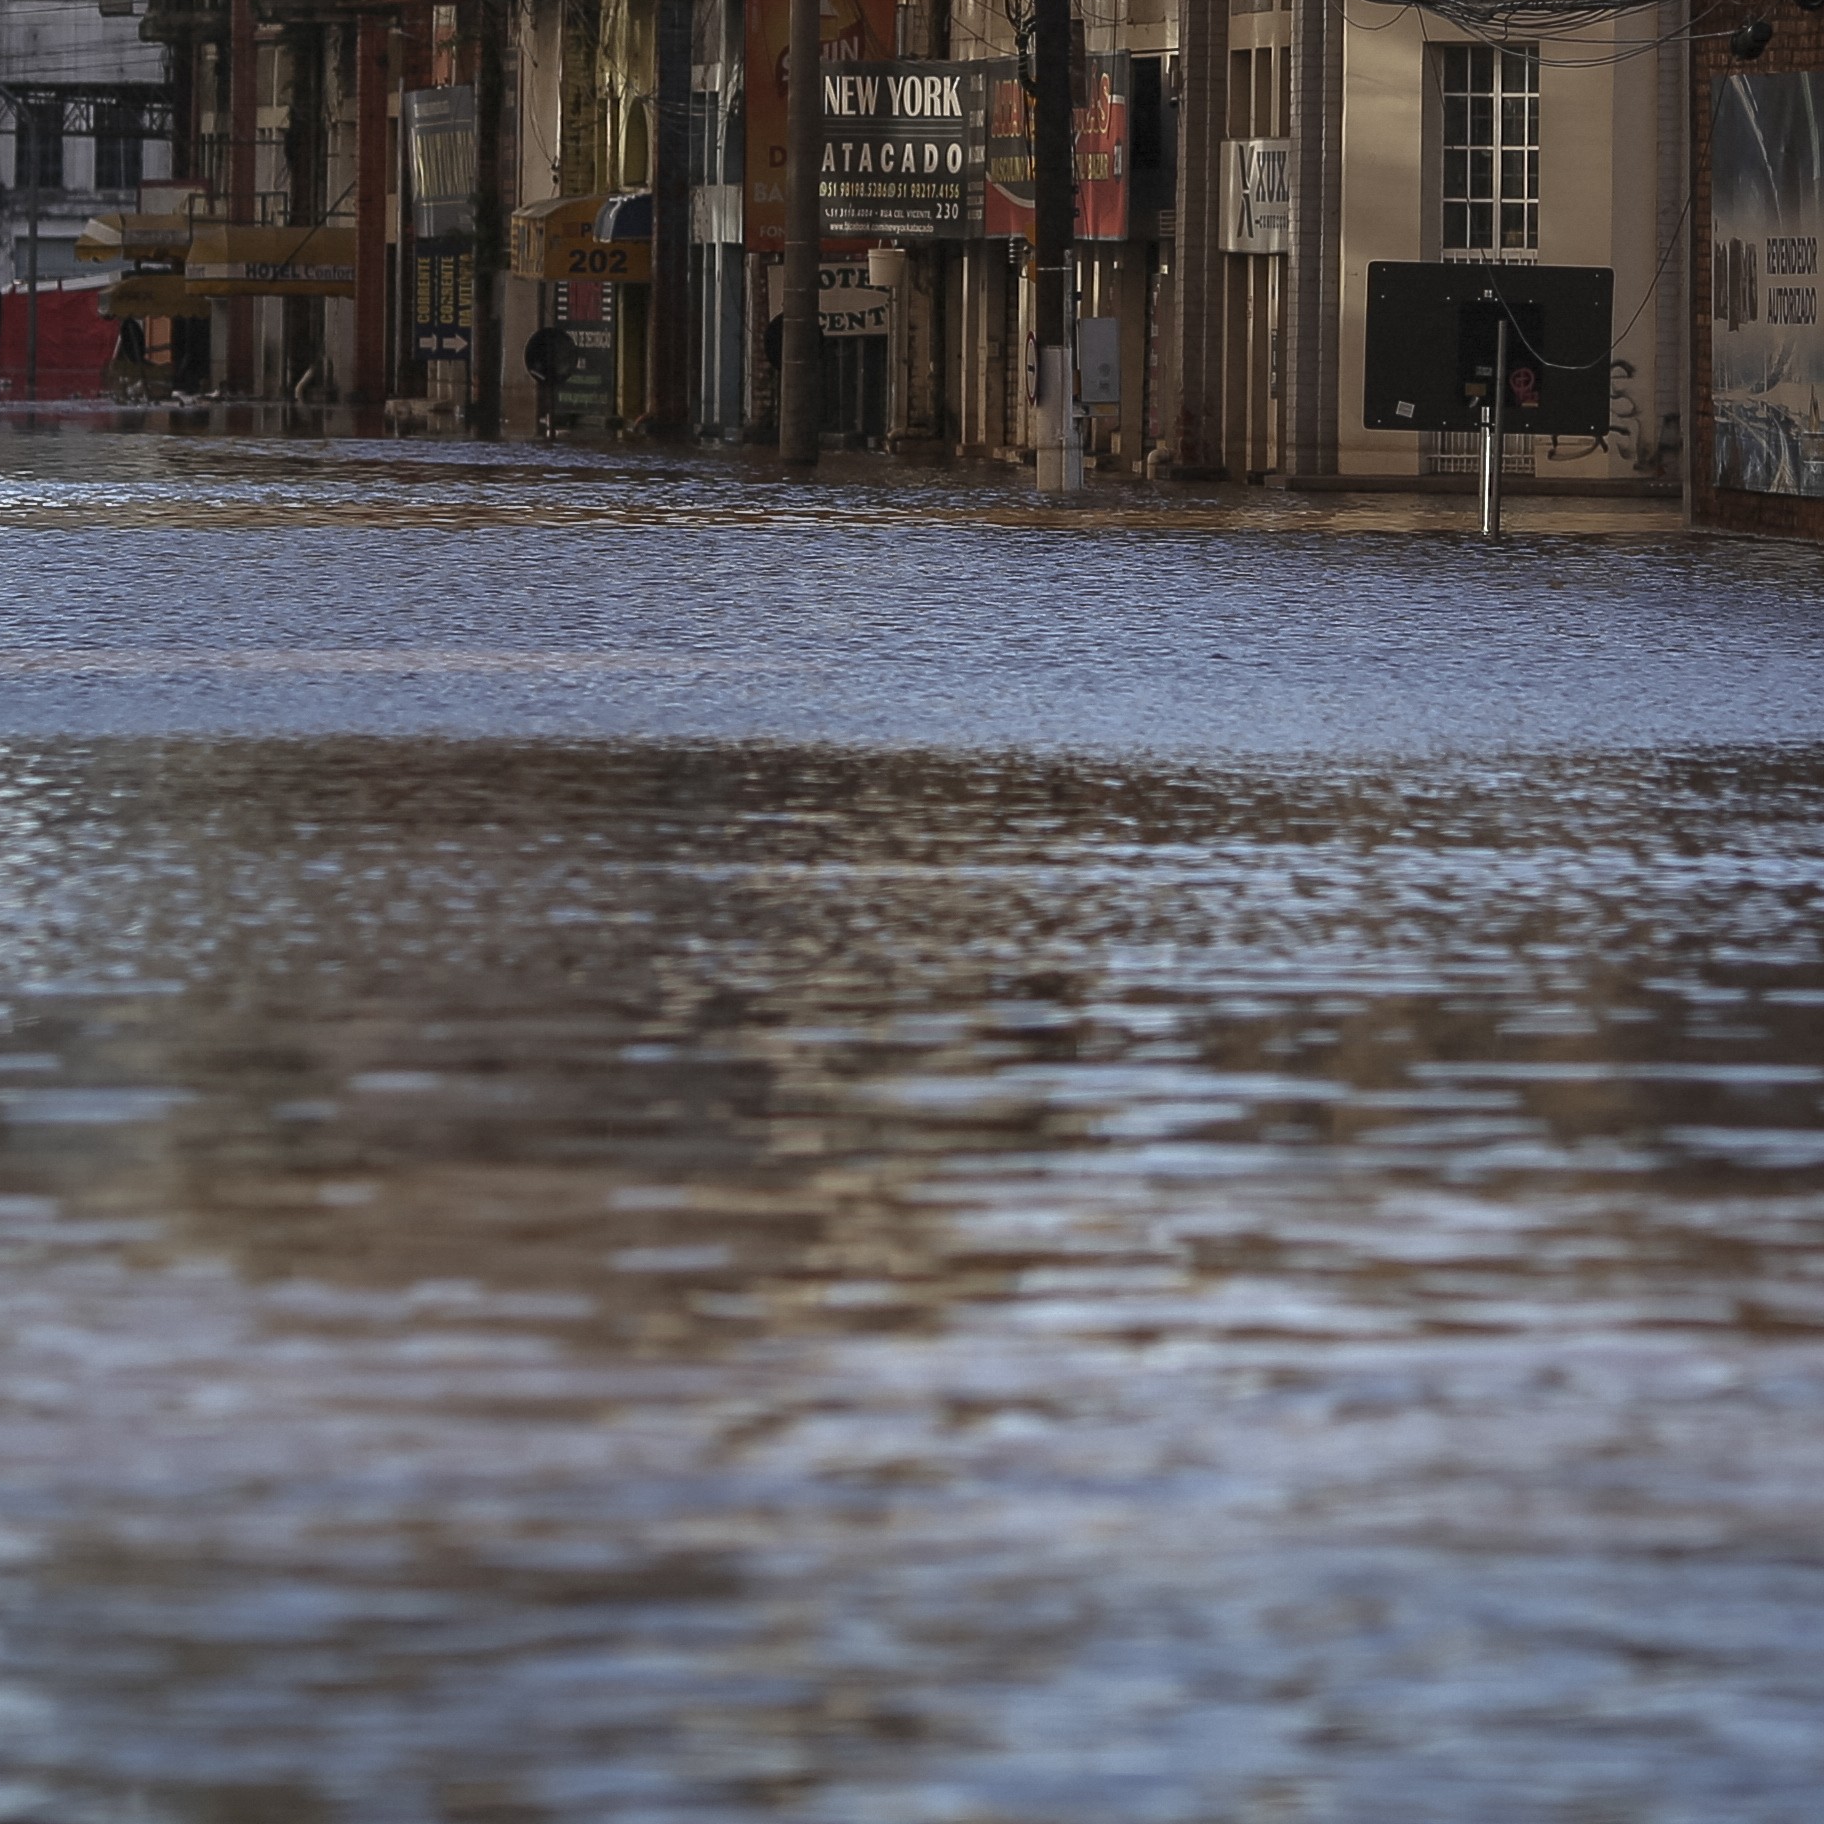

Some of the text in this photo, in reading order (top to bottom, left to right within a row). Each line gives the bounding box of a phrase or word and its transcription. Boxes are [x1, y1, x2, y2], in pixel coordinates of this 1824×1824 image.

[824, 75, 879, 116] NEW
[887, 75, 963, 117] YORK
[821, 142, 963, 174] ATACADO
[936, 202, 959, 219] 230
[244, 263, 300, 278] HOTEL
[569, 249, 628, 274] 202
[1766, 237, 1818, 275] REVENDEDOR
[1767, 286, 1817, 326] AUTORIZADO
